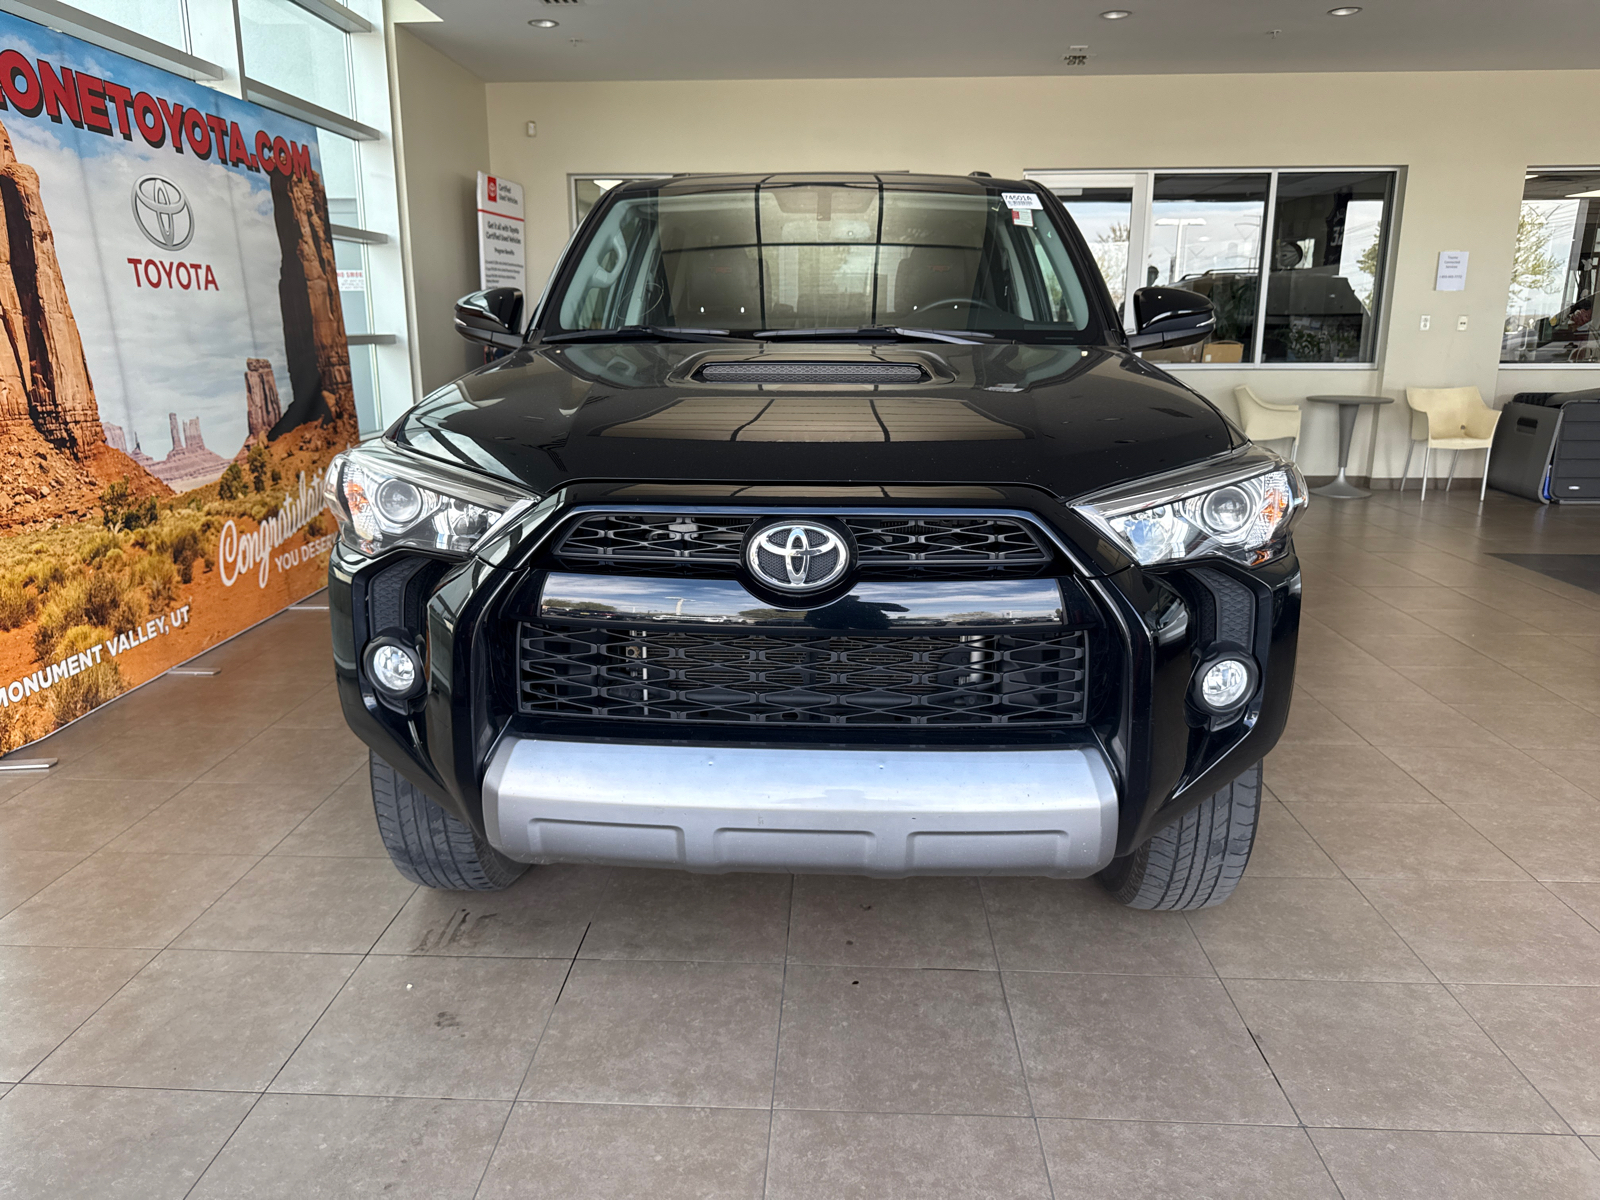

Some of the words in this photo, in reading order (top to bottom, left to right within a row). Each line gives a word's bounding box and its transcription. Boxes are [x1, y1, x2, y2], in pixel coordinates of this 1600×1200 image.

[0, 49, 313, 182] ONETOYOTA.COM
[127, 257, 220, 291] TOYOTA
[219, 467, 328, 589] Congratulati
[274, 548, 300, 573] YOU
[0, 644, 103, 708] MONUMENT
[105, 615, 170, 657] VALLEY,
[170, 605, 190, 628] UT
